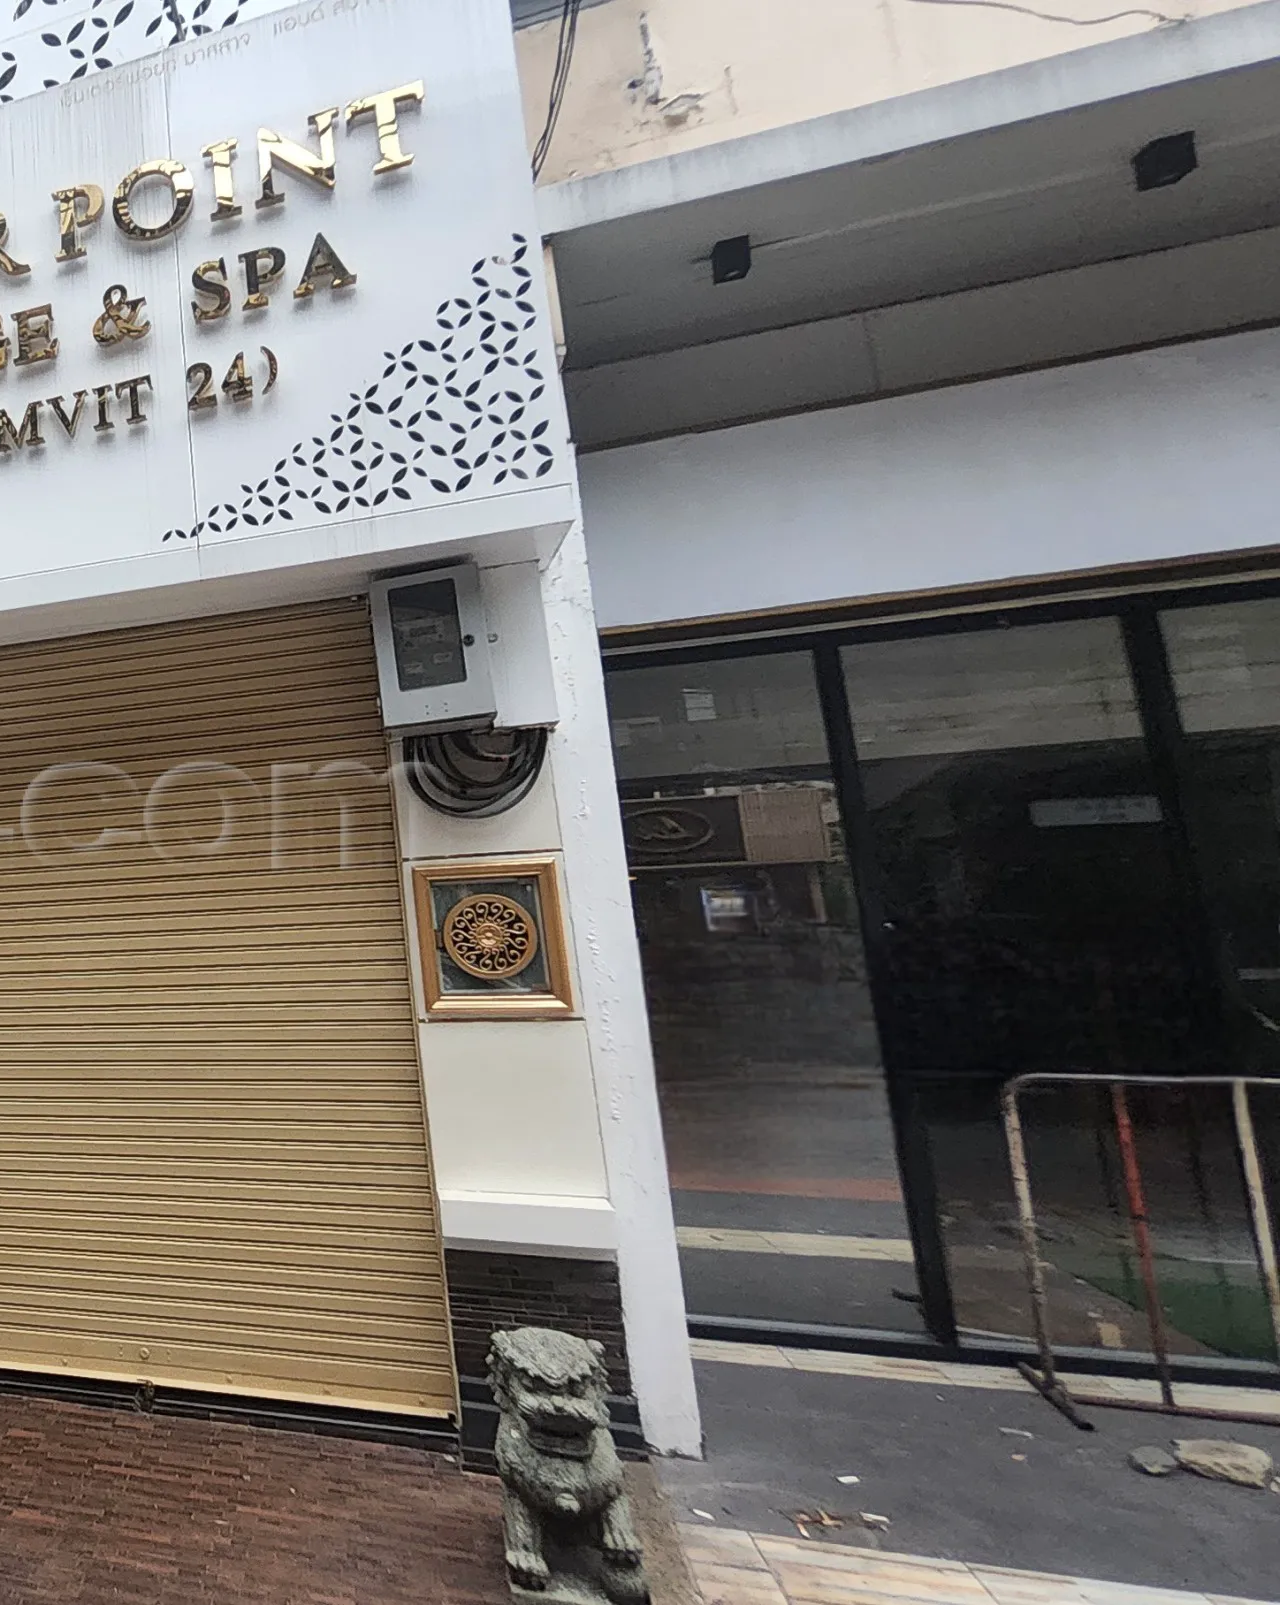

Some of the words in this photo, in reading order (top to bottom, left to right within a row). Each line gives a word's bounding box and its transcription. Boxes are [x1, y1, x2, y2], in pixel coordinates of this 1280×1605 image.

[51, 80, 425, 262] POINT
[93, 284, 151, 348] &
[192, 232, 357, 324] SPA
[186, 345, 279, 411] 24)
